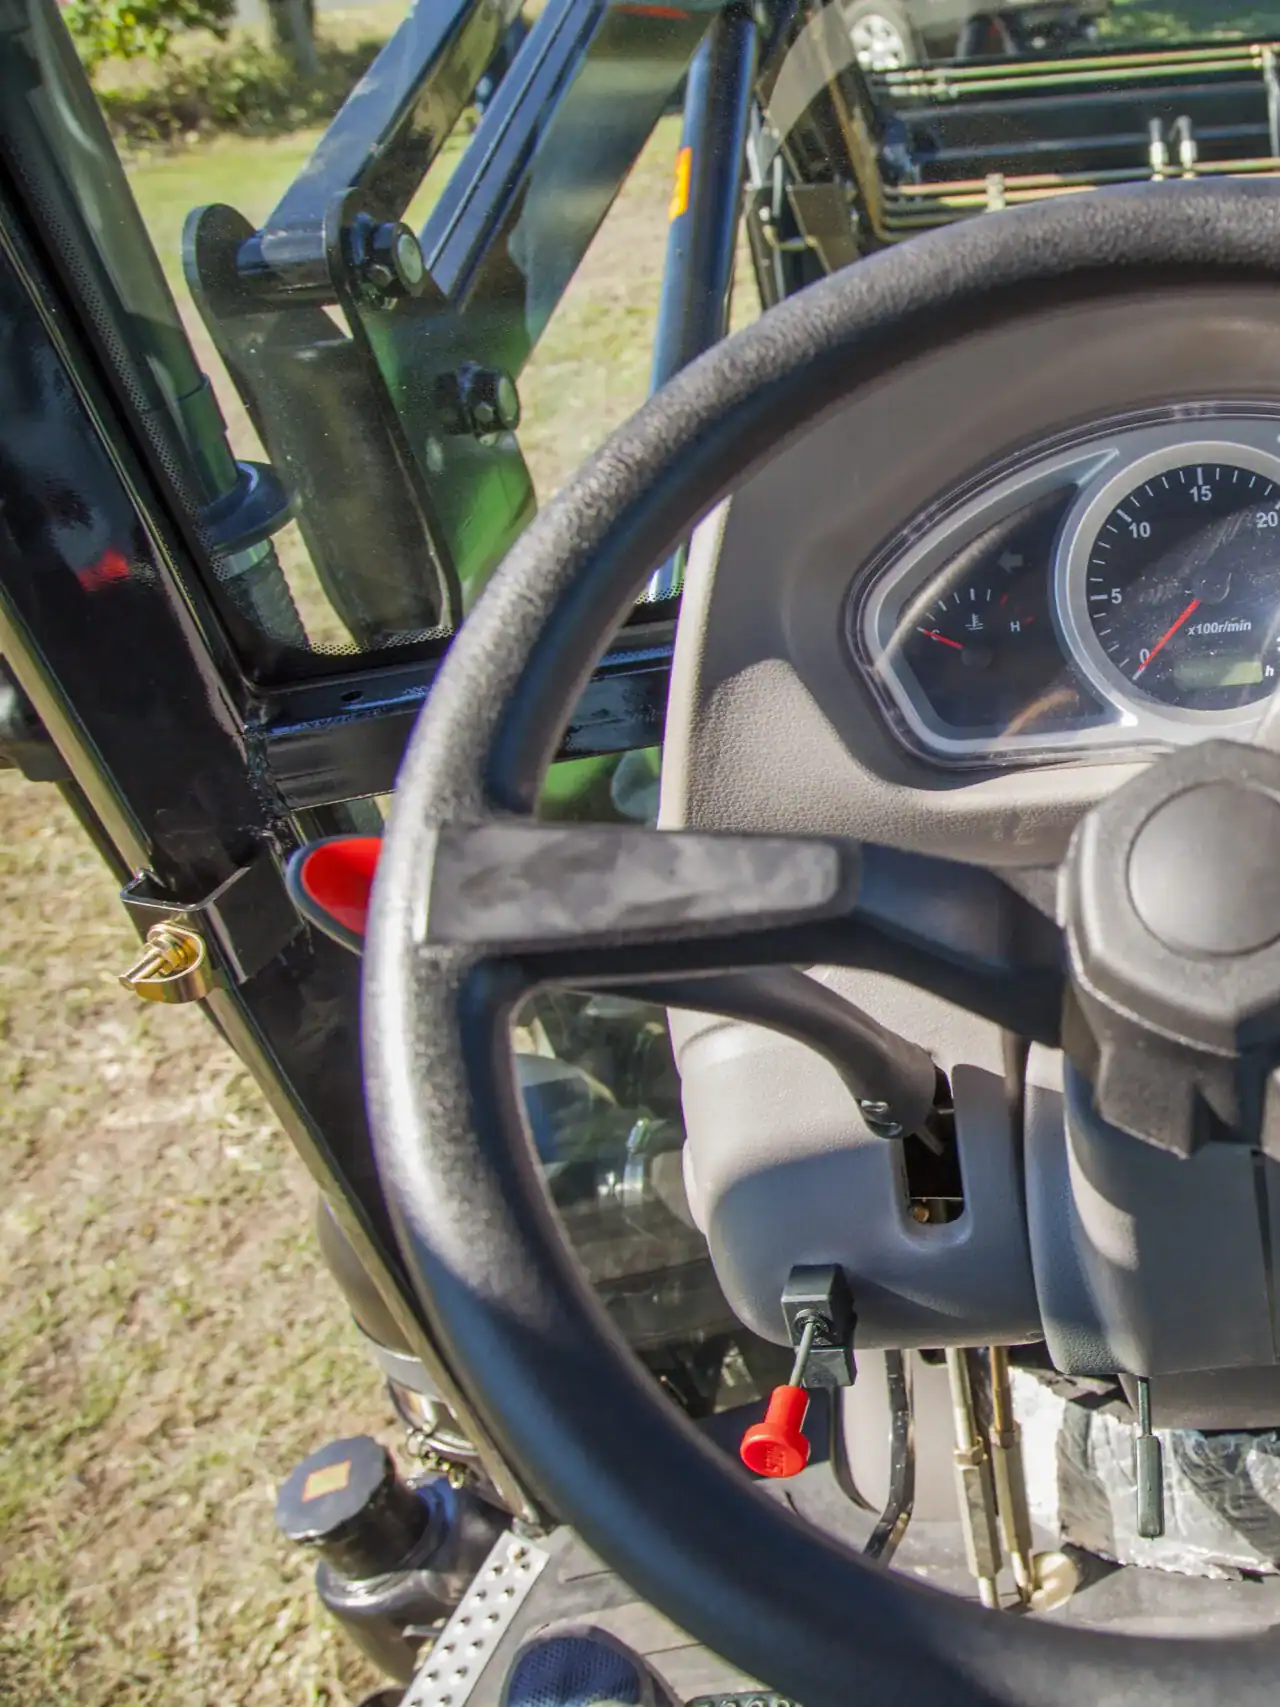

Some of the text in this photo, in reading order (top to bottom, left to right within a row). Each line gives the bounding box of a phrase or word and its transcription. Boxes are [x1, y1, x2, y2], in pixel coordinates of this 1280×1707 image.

[1189, 485, 1213, 502] 15
[1256, 511, 1279, 528] 20
[1128, 521, 1151, 539] 10
[1110, 587, 1122, 604] 5
[1010, 620, 1021, 632] H
[1187, 619, 1252, 637] x100r/min
[1139, 647, 1151, 664] 0
[1265, 664, 1275, 678] h
